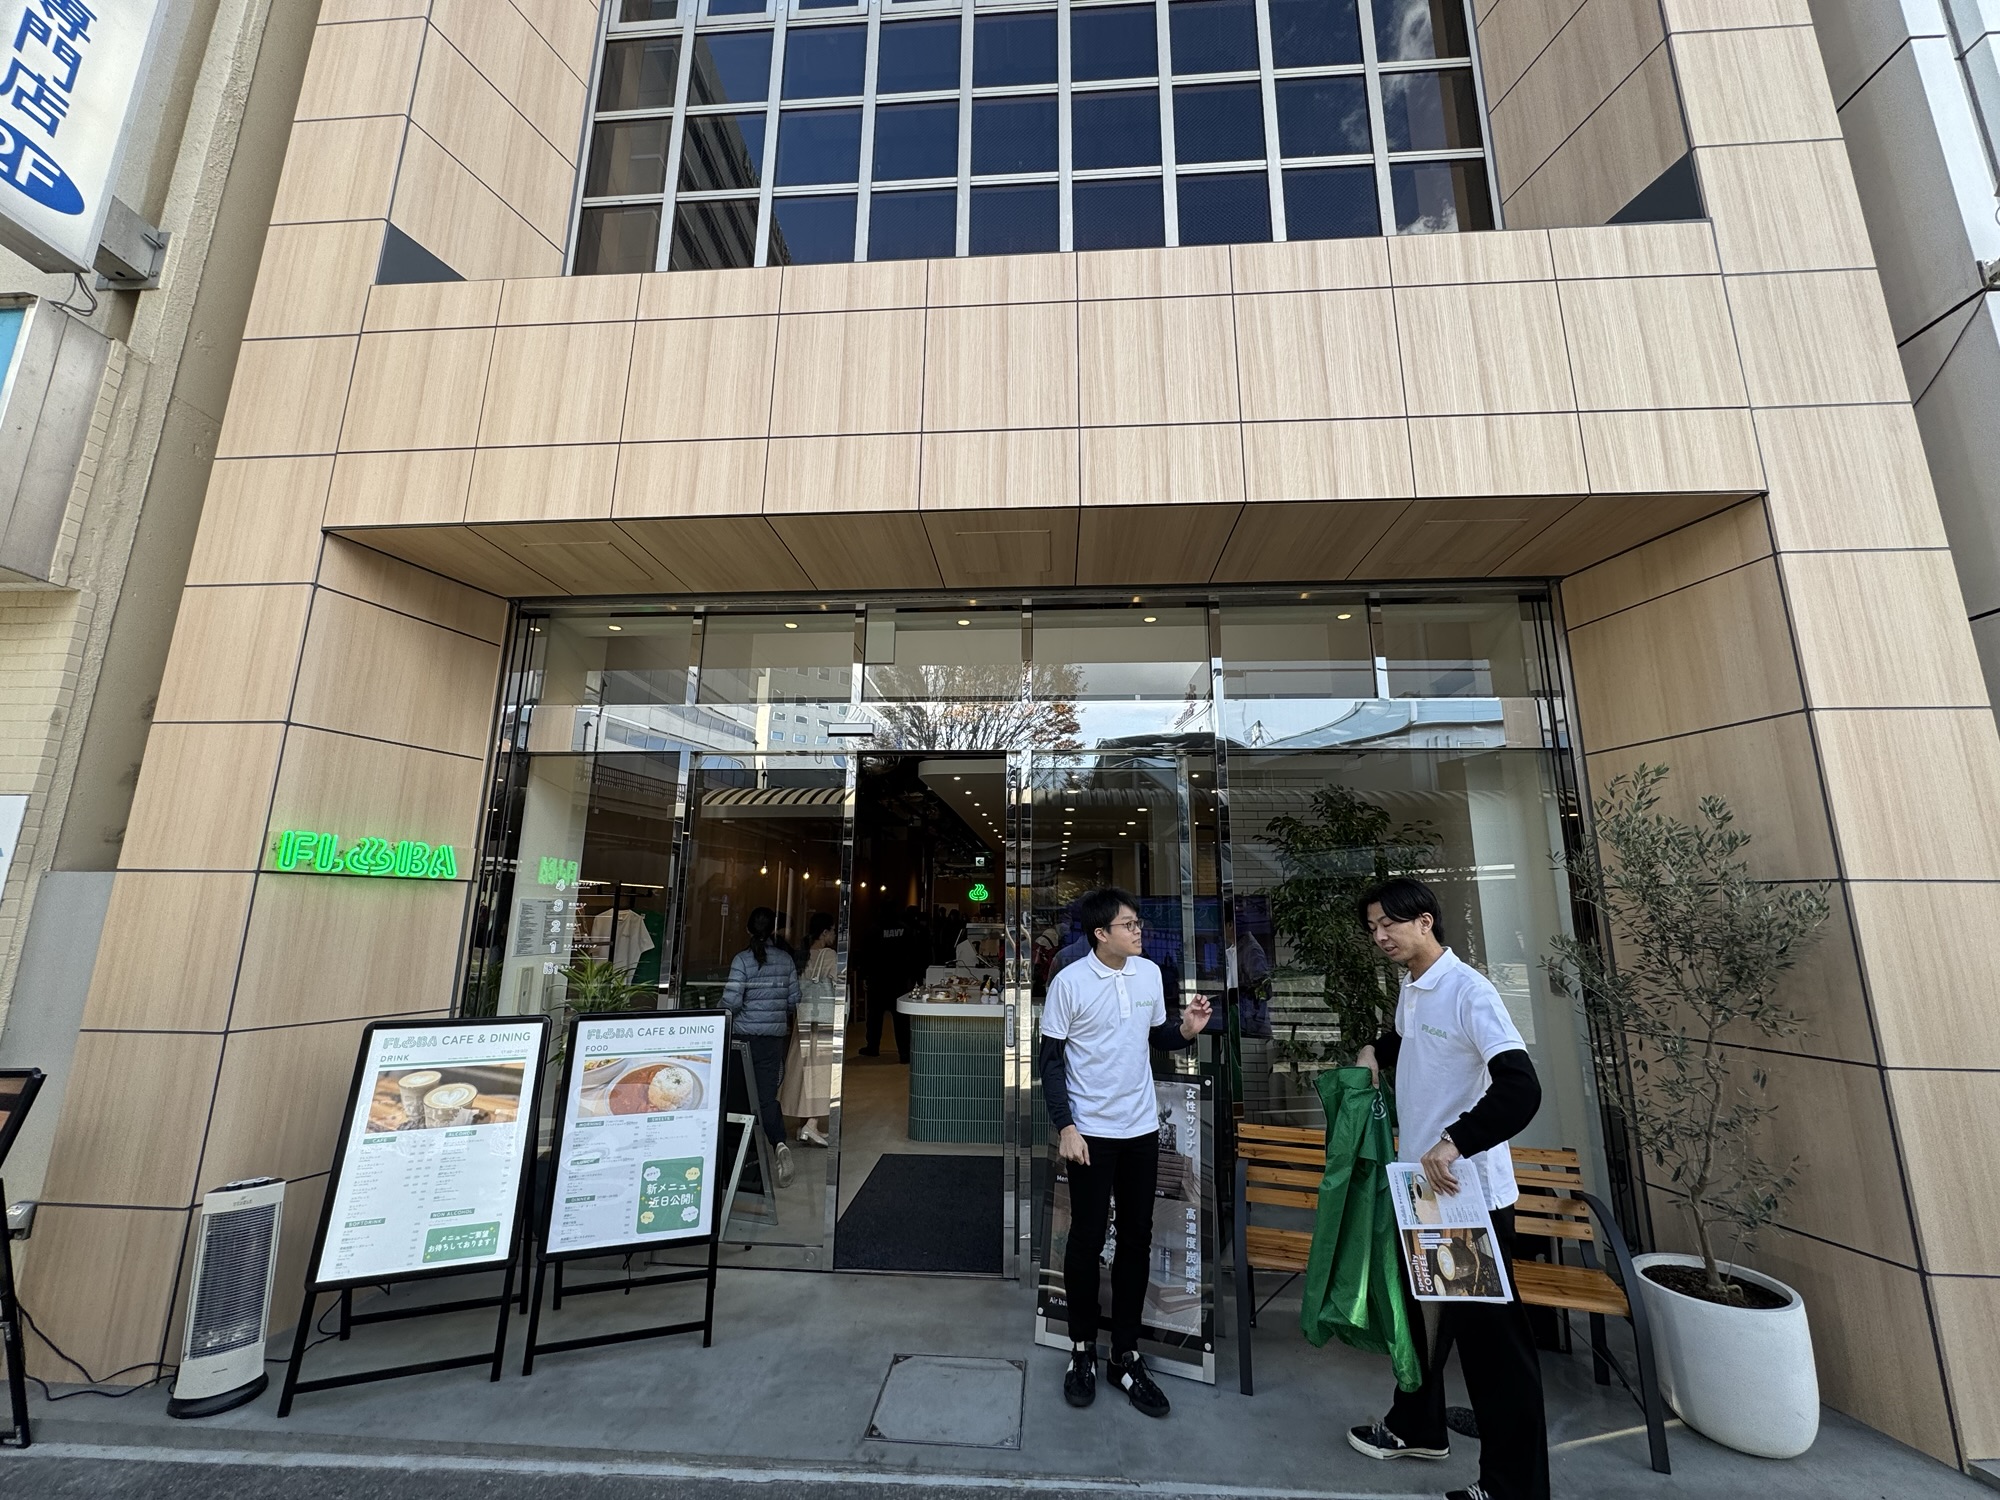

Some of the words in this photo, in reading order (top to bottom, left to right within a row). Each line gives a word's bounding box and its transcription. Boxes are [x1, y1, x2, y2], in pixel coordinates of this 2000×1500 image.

[551, 920, 561, 932] 2
[883, 928, 904, 938] NAVY
[549, 940, 557, 953] 1
[637, 1026, 666, 1037] CAFE
[668, 1026, 676, 1036] &
[679, 1024, 715, 1035] DINING
[441, 1034, 474, 1046] CAFE
[477, 1033, 486, 1044] &
[489, 1031, 531, 1043] DINING
[585, 1044, 609, 1052] FOOD
[380, 1054, 410, 1063] DRINK
[1185, 1087, 1197, 1150] 女性サウナ
[646, 1183, 698, 1195] 新メニュー
[1185, 1207, 1197, 1296] 高濃度炭酸泉
[1411, 1254, 1424, 1292] specialty
[1420, 1253, 1434, 1293] COFFEE
[1049, 1296, 1058, 1305] Air
